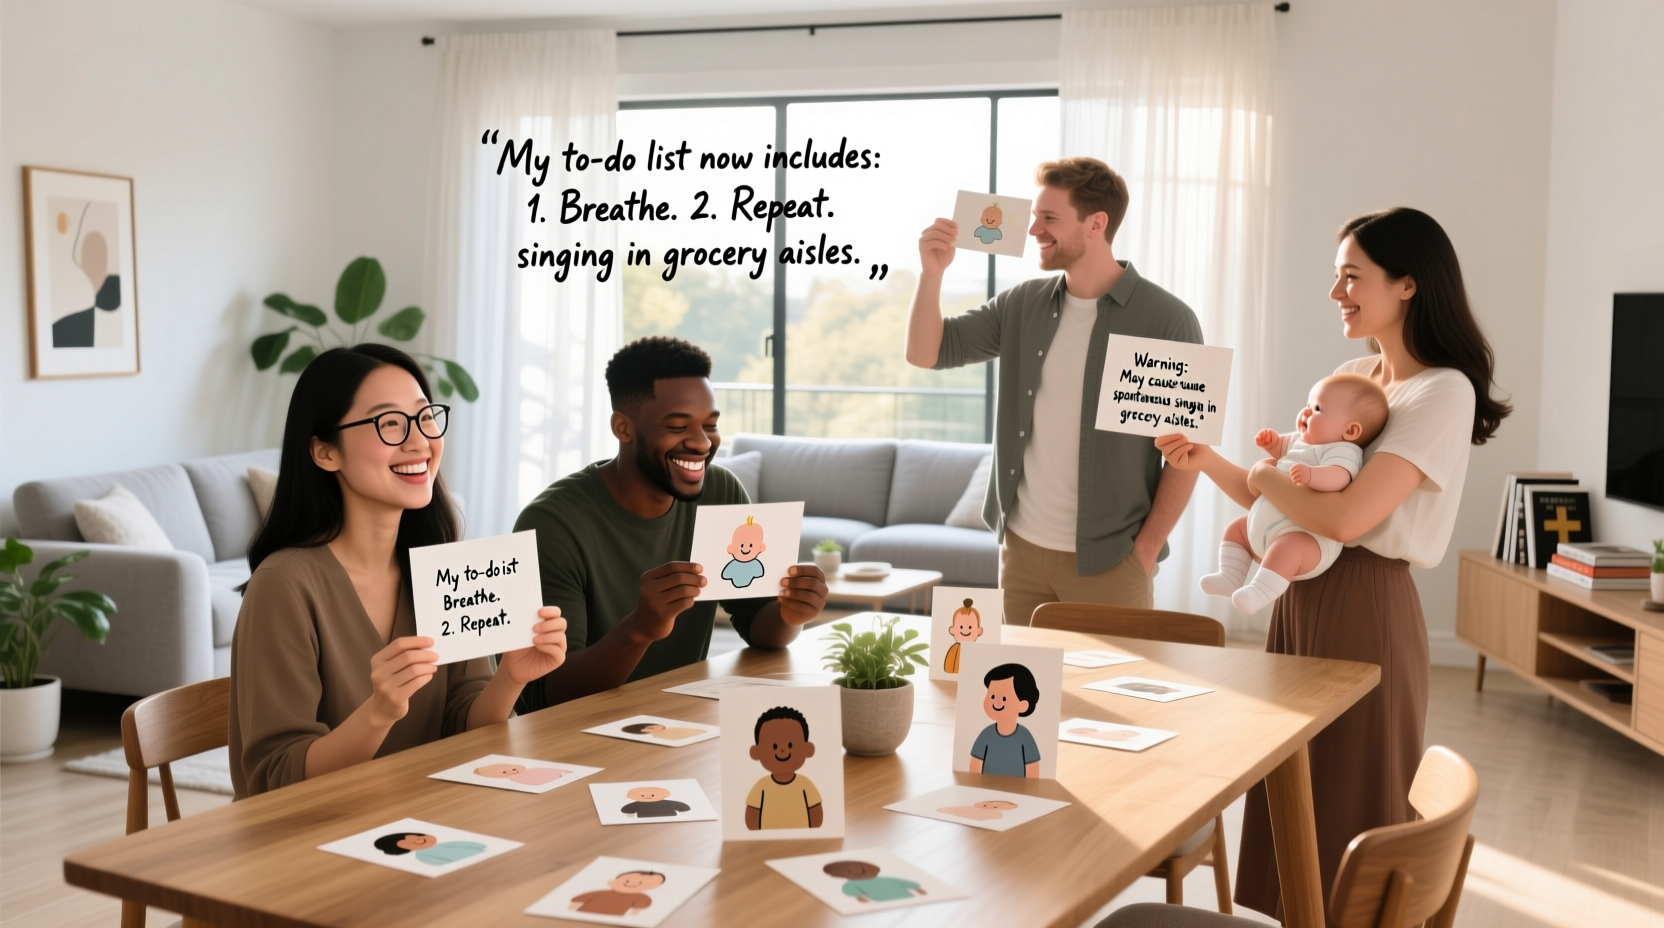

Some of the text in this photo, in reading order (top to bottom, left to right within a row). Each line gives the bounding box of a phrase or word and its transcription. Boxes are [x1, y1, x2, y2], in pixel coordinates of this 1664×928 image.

[1119, 368, 1145, 391] May
[1207, 400, 1217, 414] in
[435, 567, 460, 593] My
[443, 587, 501, 611] Breathe.
[441, 608, 511, 637] 2. Repeat.
